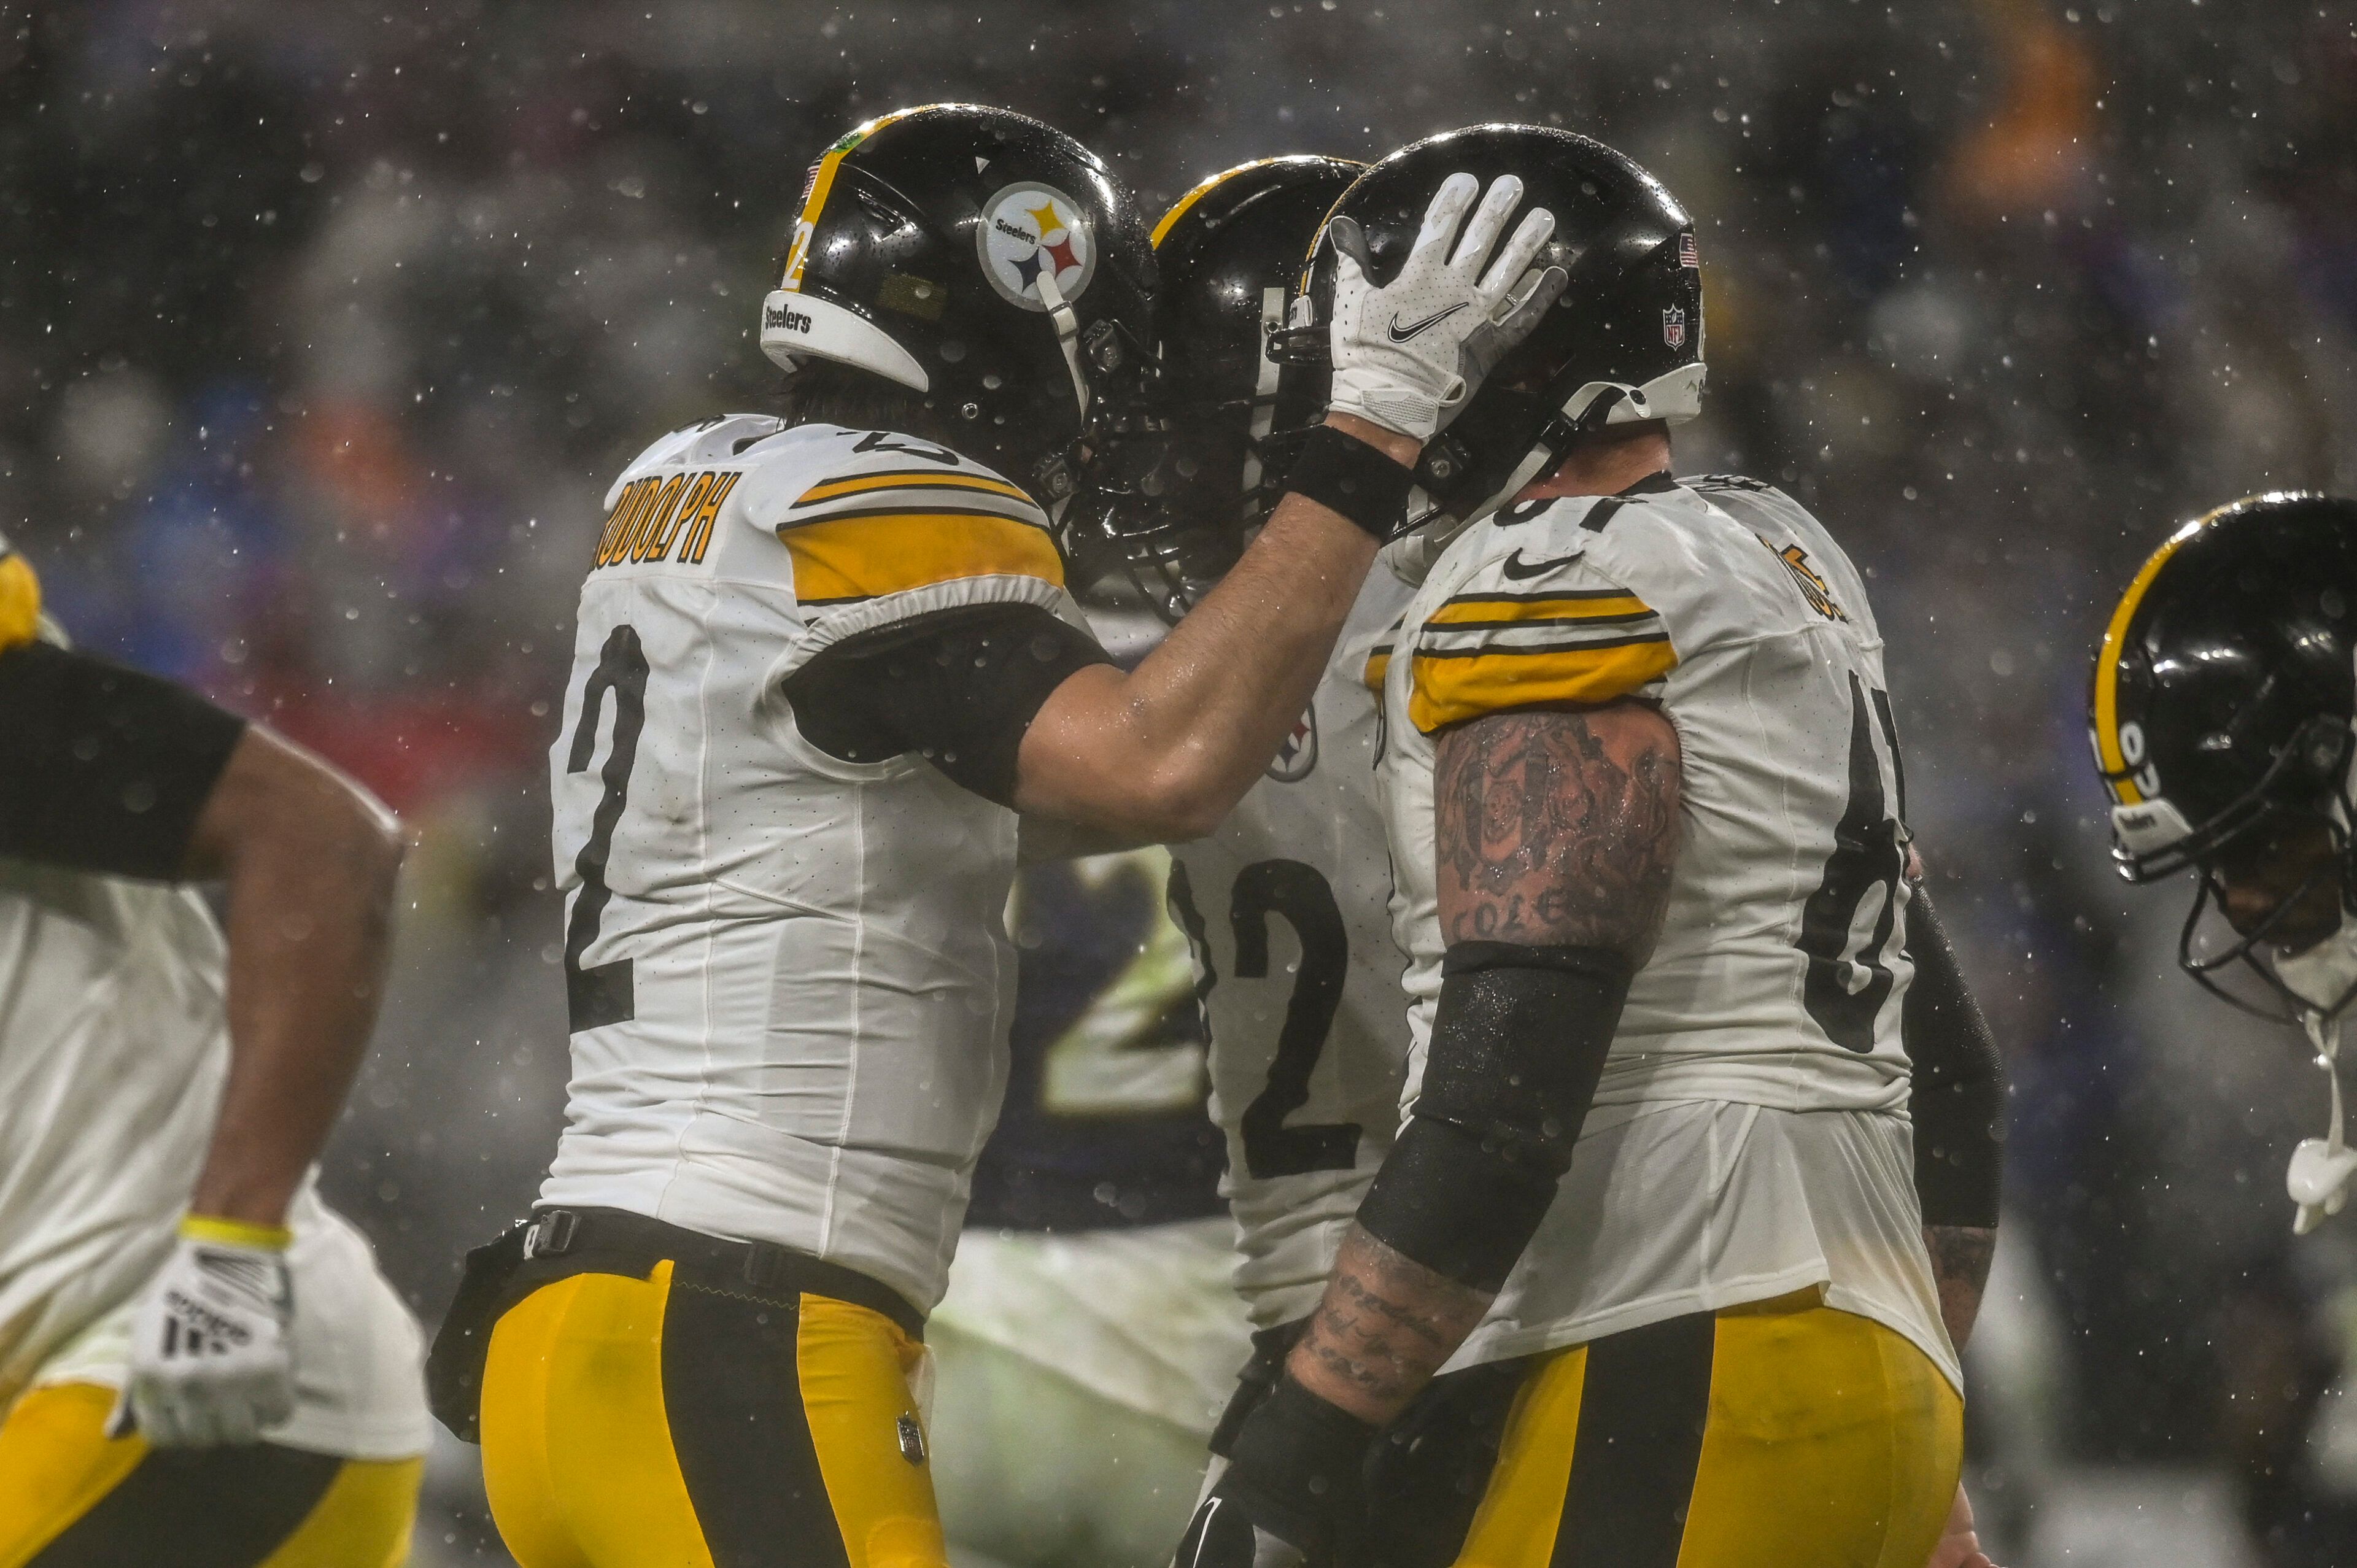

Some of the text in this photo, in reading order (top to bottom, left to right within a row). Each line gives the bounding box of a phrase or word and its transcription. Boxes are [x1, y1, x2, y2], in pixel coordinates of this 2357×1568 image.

[780, 221, 814, 290] 2
[996, 218, 1036, 244] Steelers
[765, 304, 812, 334] Steelers
[1666, 325, 1683, 345] NFL
[566, 624, 649, 1035] 2
[1003, 843, 1209, 1112] 2
[1164, 857, 1363, 1180] 2
